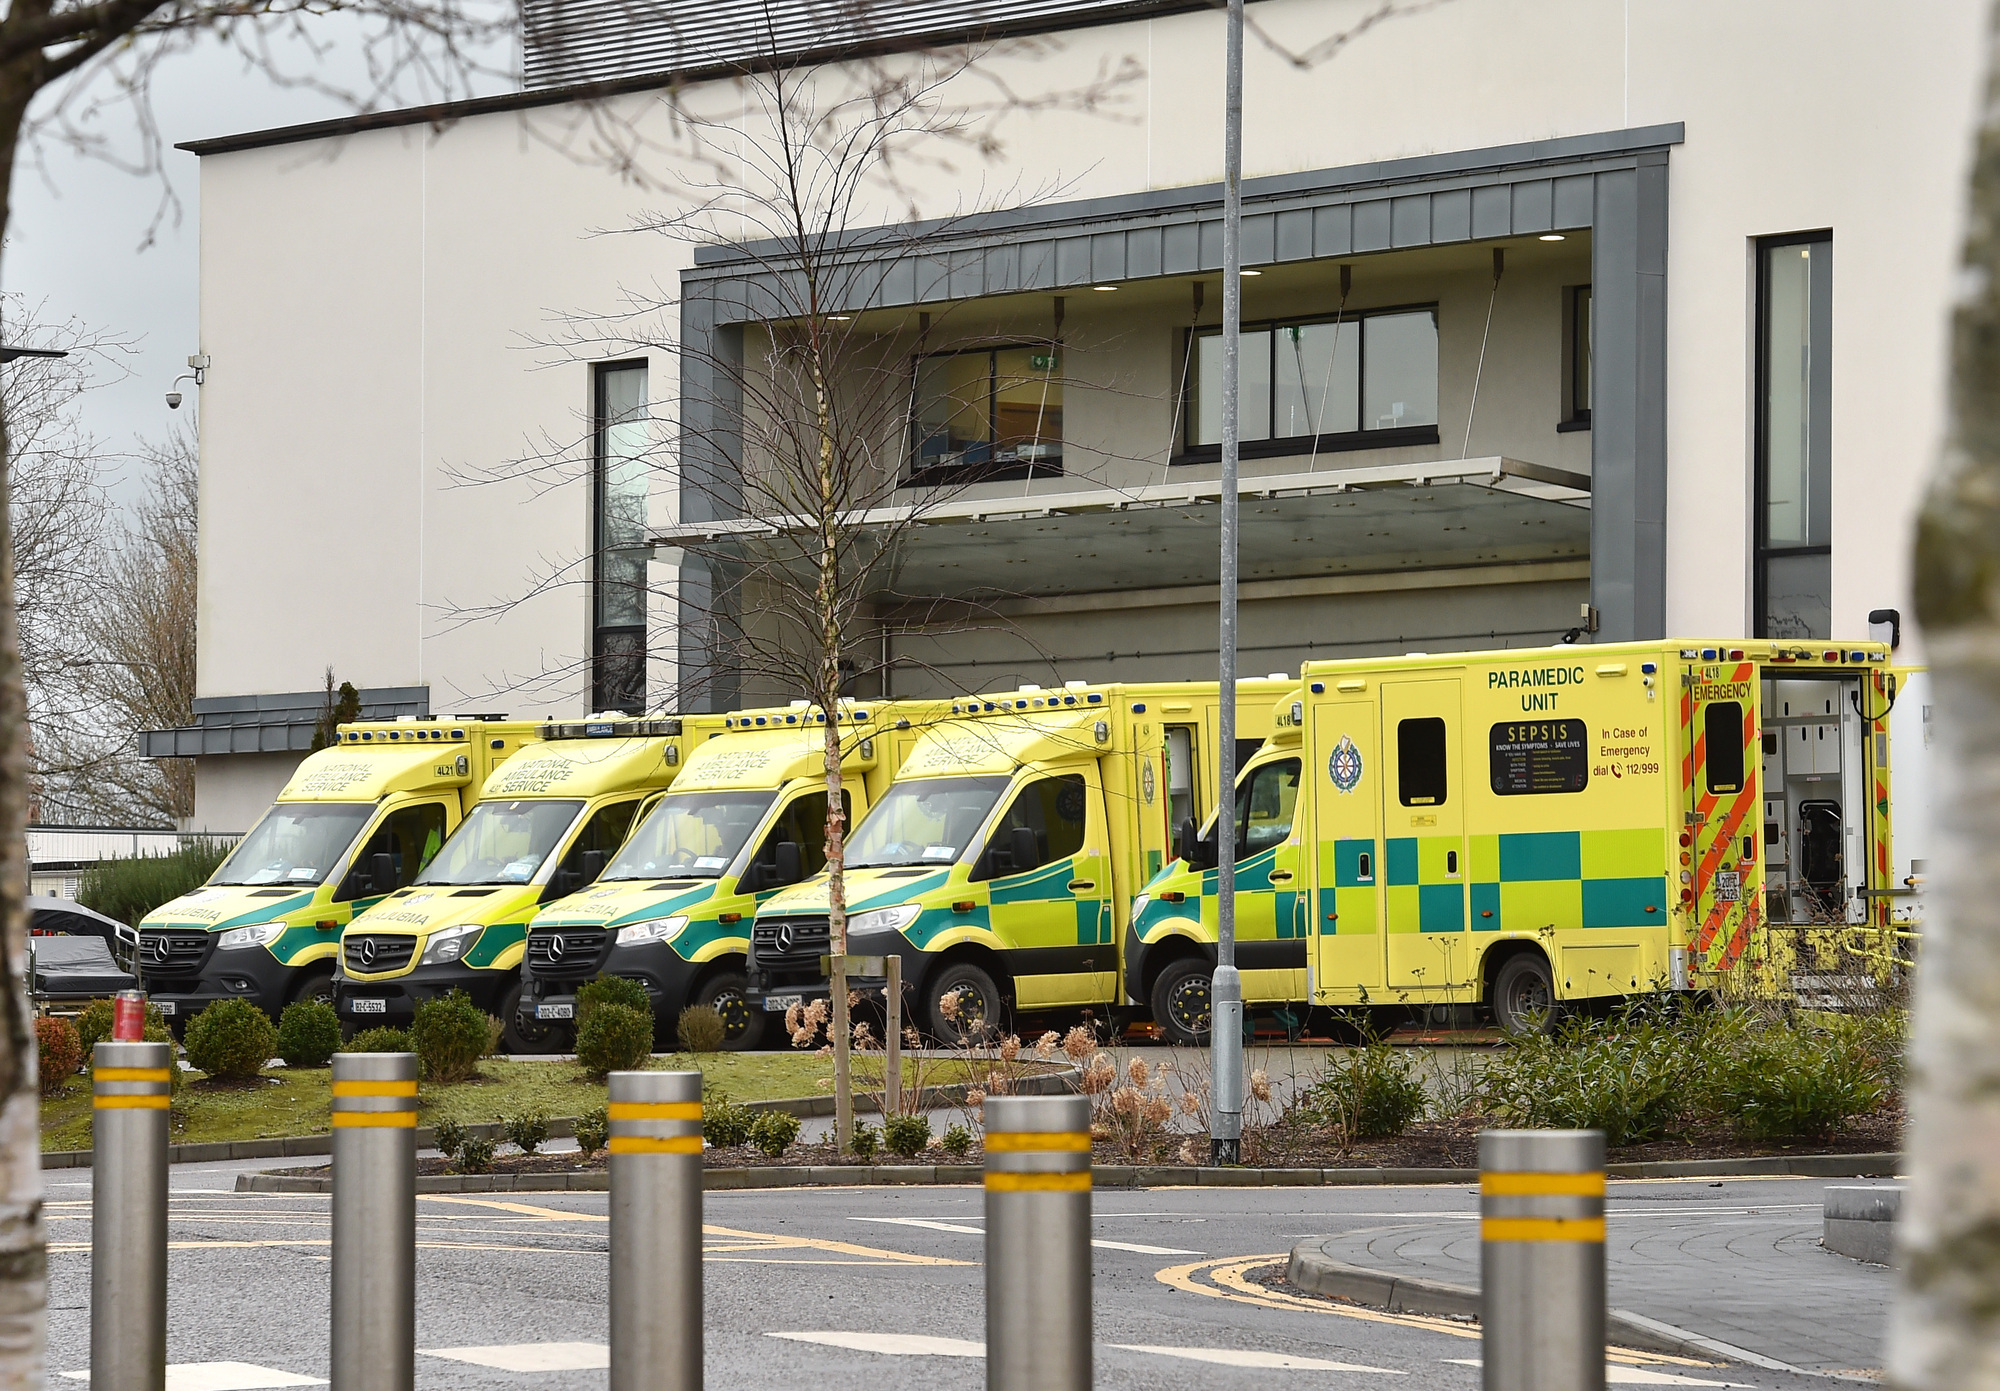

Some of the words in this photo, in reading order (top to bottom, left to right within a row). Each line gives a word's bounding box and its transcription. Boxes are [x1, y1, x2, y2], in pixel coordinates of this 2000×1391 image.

[1488, 666, 1584, 689] PARAMEDIC
[1704, 667, 1720, 679] 4L18
[1694, 682, 1752, 701] EMERGENCY
[1521, 693, 1558, 711] UNIT
[1276, 715, 1291, 726] 4L18
[1508, 724, 1567, 742] SEPSIS
[1602, 728, 1610, 739] In
[1613, 727, 1635, 739] Case
[1639, 726, 1648, 738] of
[1521, 742, 1548, 750] SYMPTOMS
[1555, 741, 1567, 749] SAVE
[1600, 745, 1650, 758] Emergency
[436, 765, 454, 776] 4L21
[518, 759, 573, 770] NATIONAL
[1593, 765, 1609, 777] dial
[1626, 763, 1659, 776] 112/999
[302, 773, 373, 783] AMBULANCE
[501, 770, 574, 782] AMBULANCE
[301, 782, 351, 793] SERVICE
[502, 780, 552, 793] SERVICE
